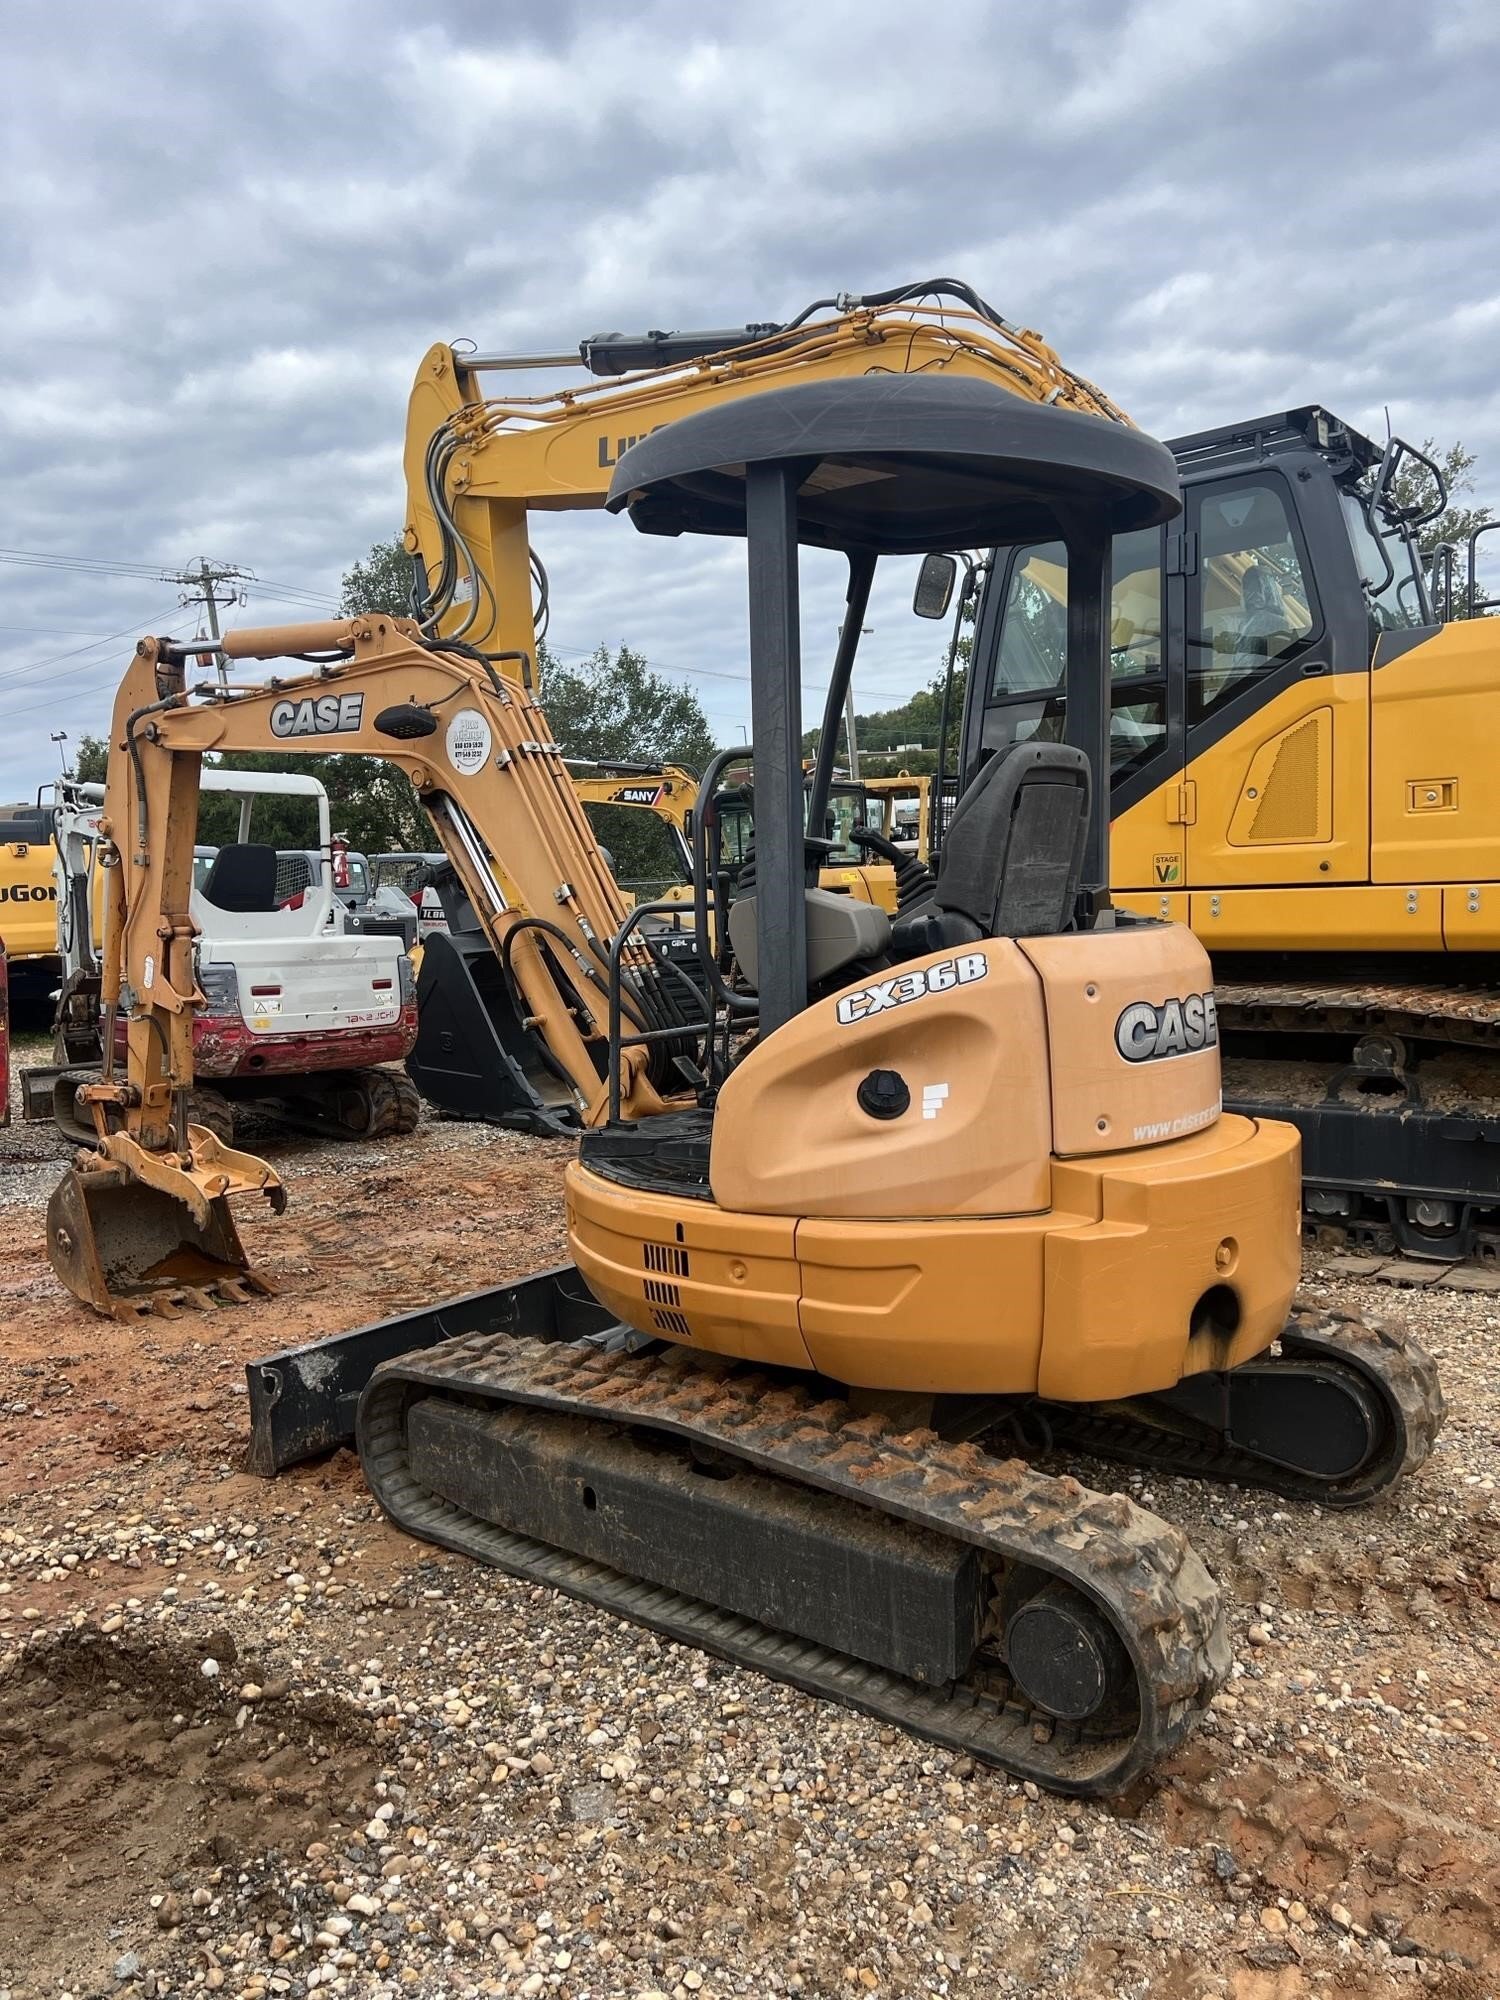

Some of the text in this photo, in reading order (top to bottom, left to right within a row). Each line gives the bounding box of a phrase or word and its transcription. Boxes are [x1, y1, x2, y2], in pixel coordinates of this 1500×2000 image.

[270, 692, 364, 738] CASE
[623, 790, 655, 801] SANY
[1155, 855, 1180, 863] STAGE
[1155, 864, 1171, 883] V
[671, 939, 688, 947] GEHL
[836, 953, 988, 1025] CX36B
[1115, 991, 1217, 1063] CASE
